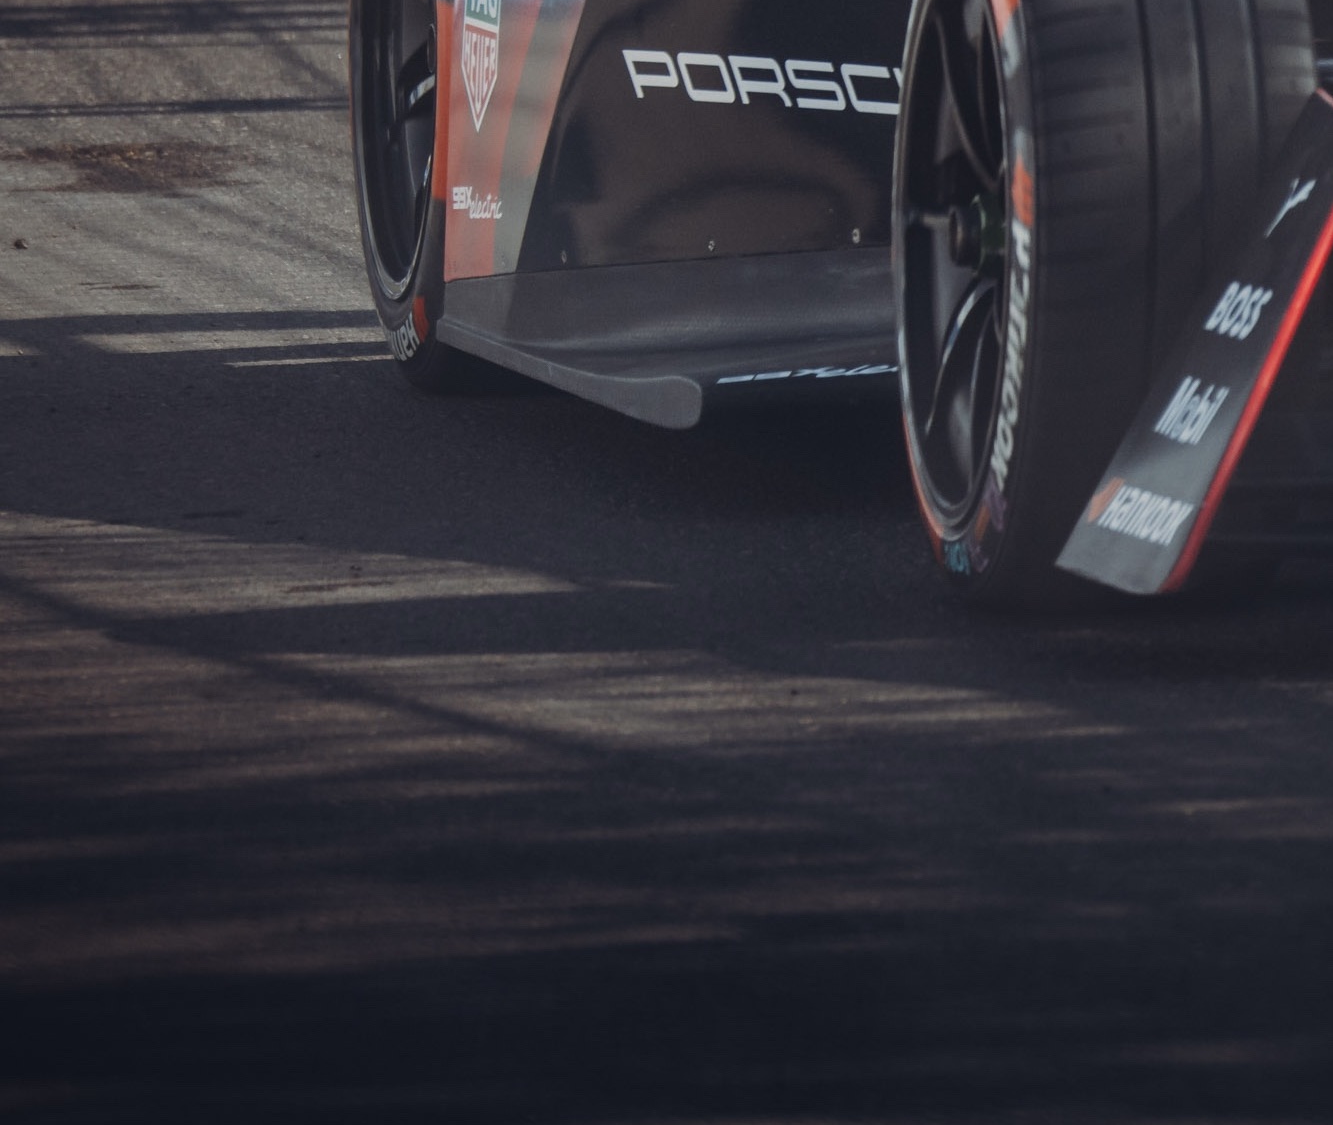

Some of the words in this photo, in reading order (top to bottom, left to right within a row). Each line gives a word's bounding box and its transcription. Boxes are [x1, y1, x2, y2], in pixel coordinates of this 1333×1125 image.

[463, 29, 497, 116] HEUER
[622, 49, 902, 116] PORSC
[1204, 280, 1274, 341] BOSS
[1154, 375, 1230, 446] Mobil
